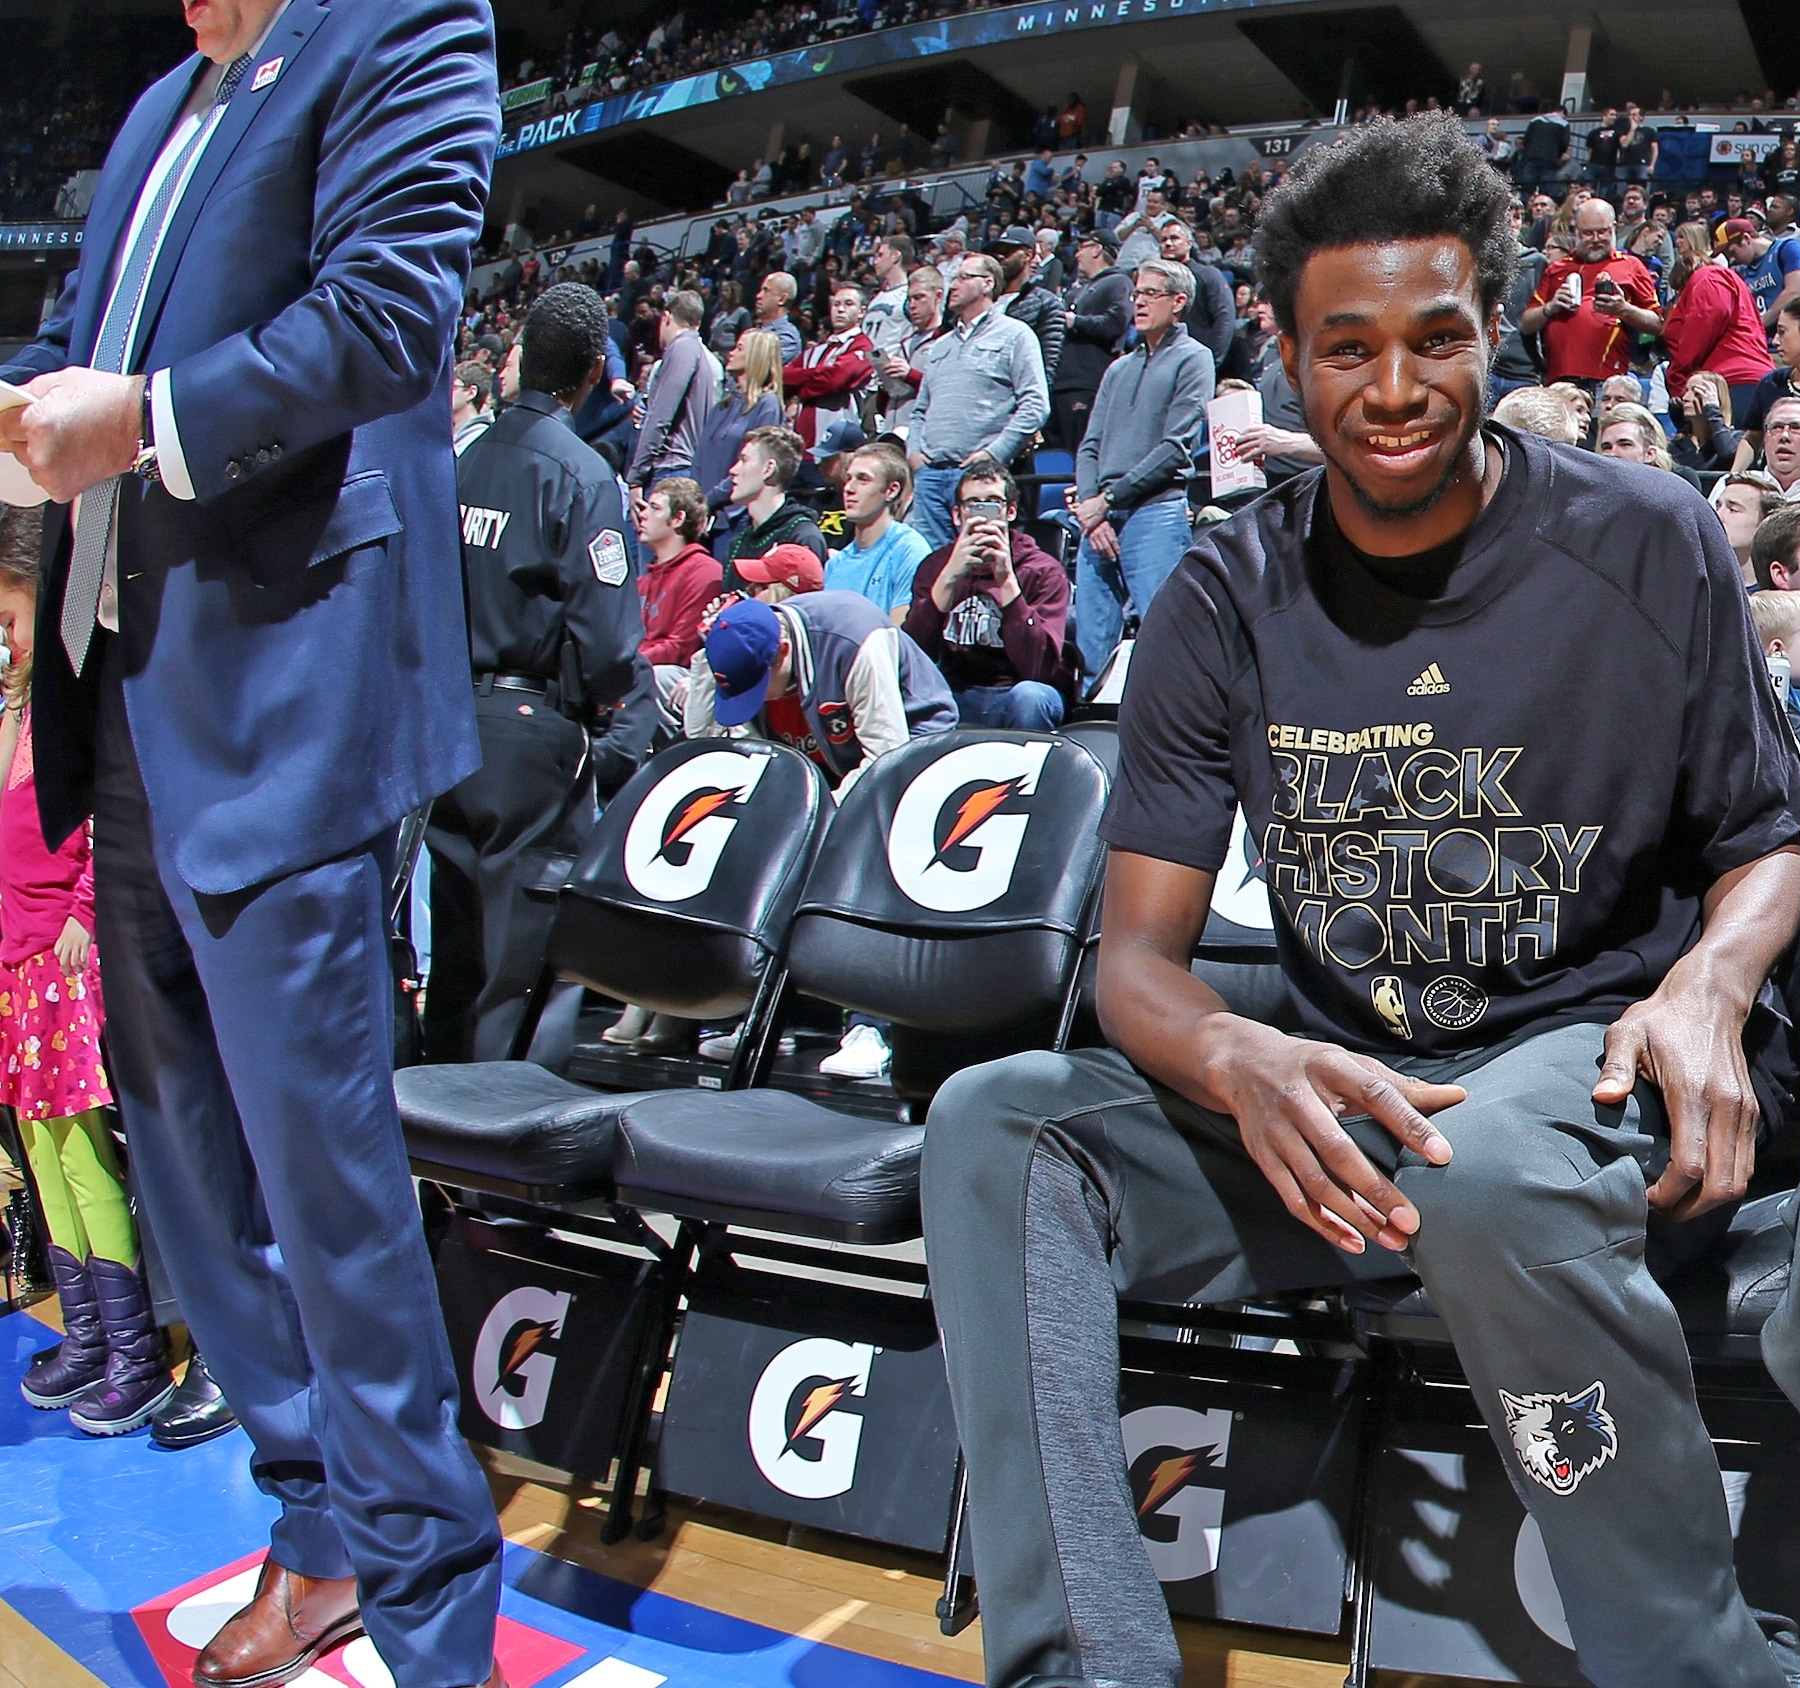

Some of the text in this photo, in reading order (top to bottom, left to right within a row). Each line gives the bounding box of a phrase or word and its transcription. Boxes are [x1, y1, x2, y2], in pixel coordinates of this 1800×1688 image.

[1017, 0, 1237, 31] MINNESO
[517, 109, 581, 150] PACK
[1264, 138, 1291, 154] 131
[1734, 142, 1766, 156] sun
[0, 232, 84, 245] INNESO
[1406, 682, 1451, 696] adidas
[1267, 722, 1435, 755] CELEBRATING
[1271, 747, 1524, 824] BLACK
[624, 751, 773, 902] G
[888, 741, 1055, 912] G
[1263, 823, 1604, 900] HISTORY
[473, 1286, 572, 1430] G
[748, 1337, 876, 1499] G
